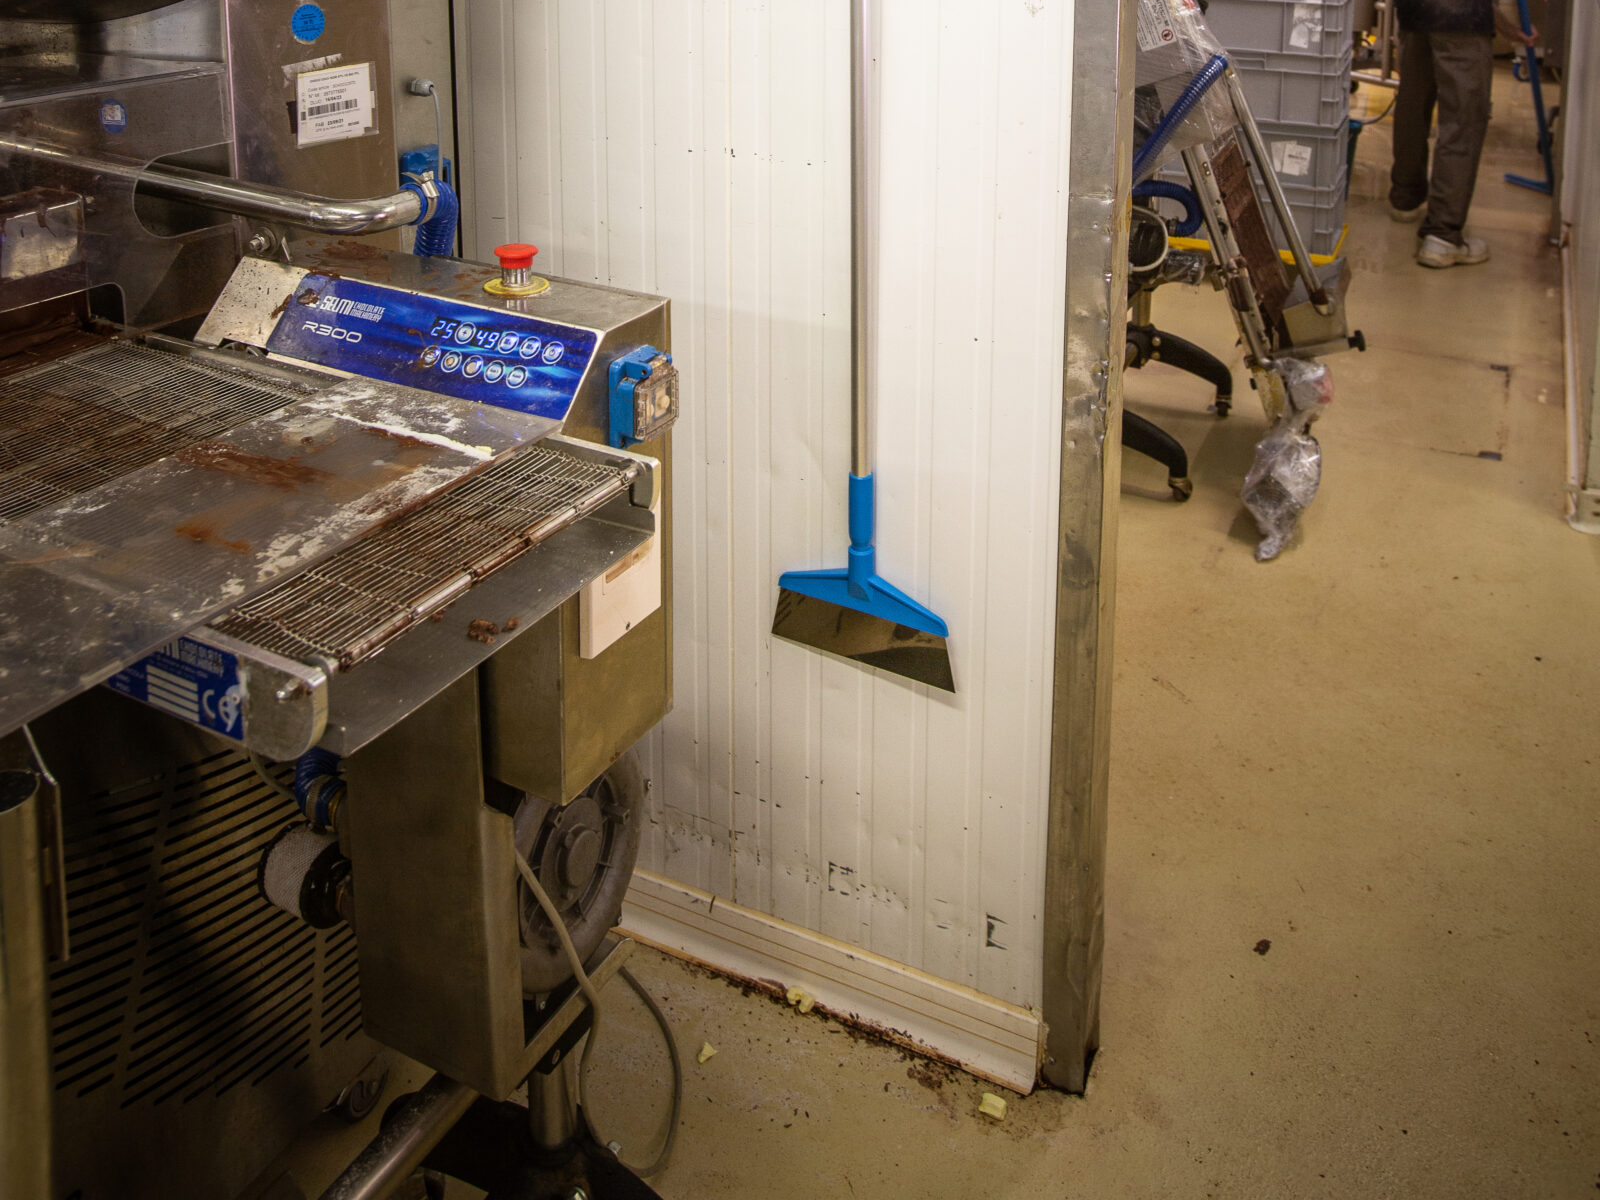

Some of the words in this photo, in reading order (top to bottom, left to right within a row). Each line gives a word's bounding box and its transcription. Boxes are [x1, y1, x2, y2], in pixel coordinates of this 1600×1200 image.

[320, 295, 355, 316] SELMI
[302, 320, 362, 343] R300
[430, 320, 458, 340] 25
[475, 329, 500, 349] 49
